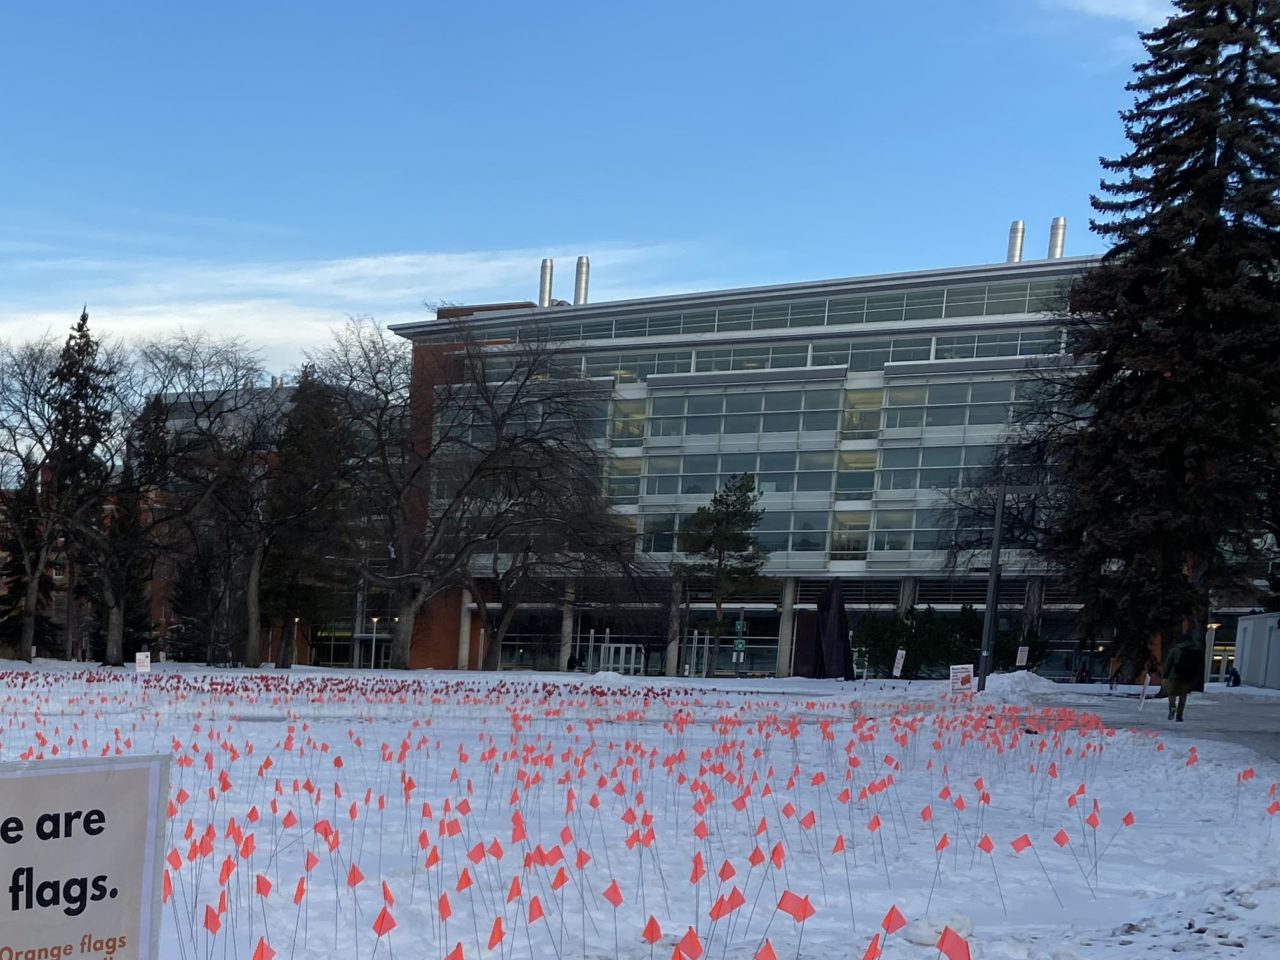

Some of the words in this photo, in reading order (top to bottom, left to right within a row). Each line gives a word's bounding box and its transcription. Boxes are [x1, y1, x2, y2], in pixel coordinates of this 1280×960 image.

[36, 809, 106, 841] are
[9, 867, 118, 917] flags.
[80, 934, 127, 955] flags
